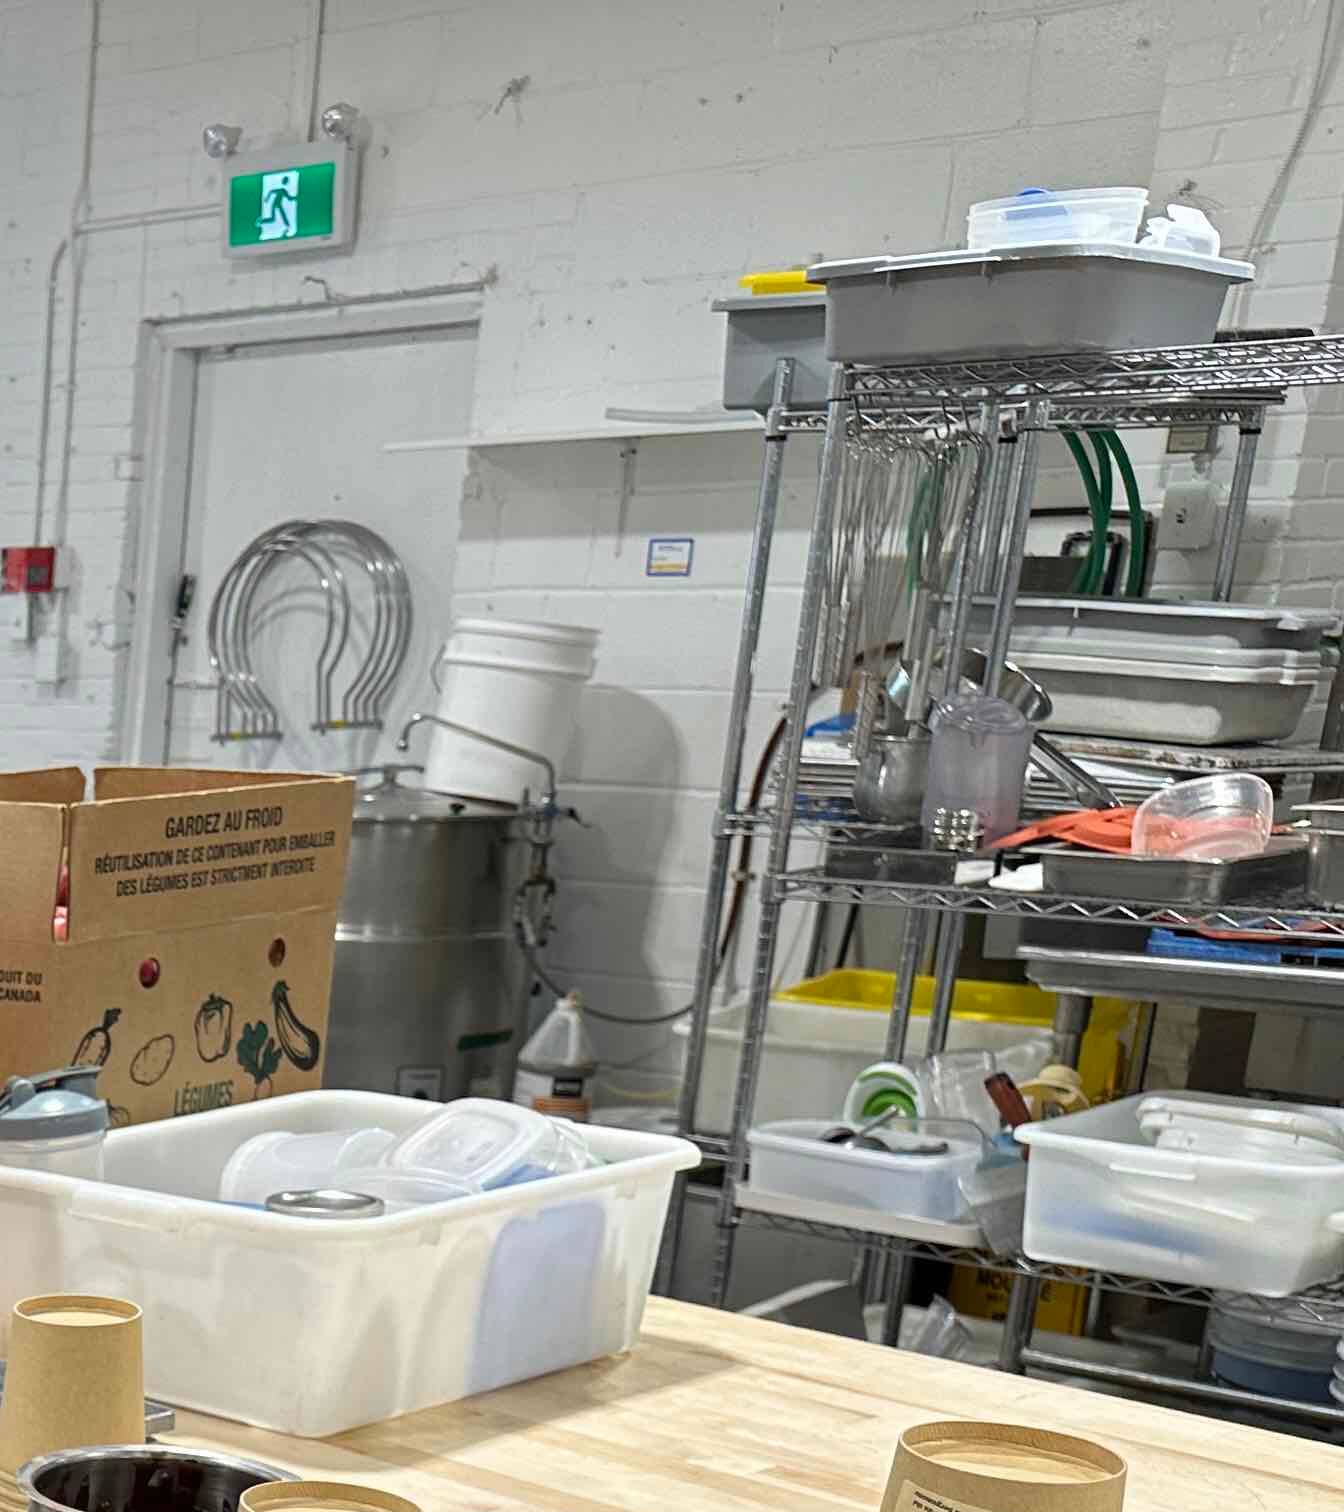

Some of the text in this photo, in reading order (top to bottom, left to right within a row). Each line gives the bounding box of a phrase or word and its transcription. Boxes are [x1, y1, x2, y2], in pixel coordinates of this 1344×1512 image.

[165, 806, 283, 839] GARDEZ AU FROID
[95, 830, 335, 875] RÉUTILISATION DE CE CONTENANT POUR EMBALLER
[116, 880, 137, 897] DES
[140, 871, 189, 895] LÉGUMES
[191, 872, 209, 889] EST
[26, 972, 42, 985] DU
